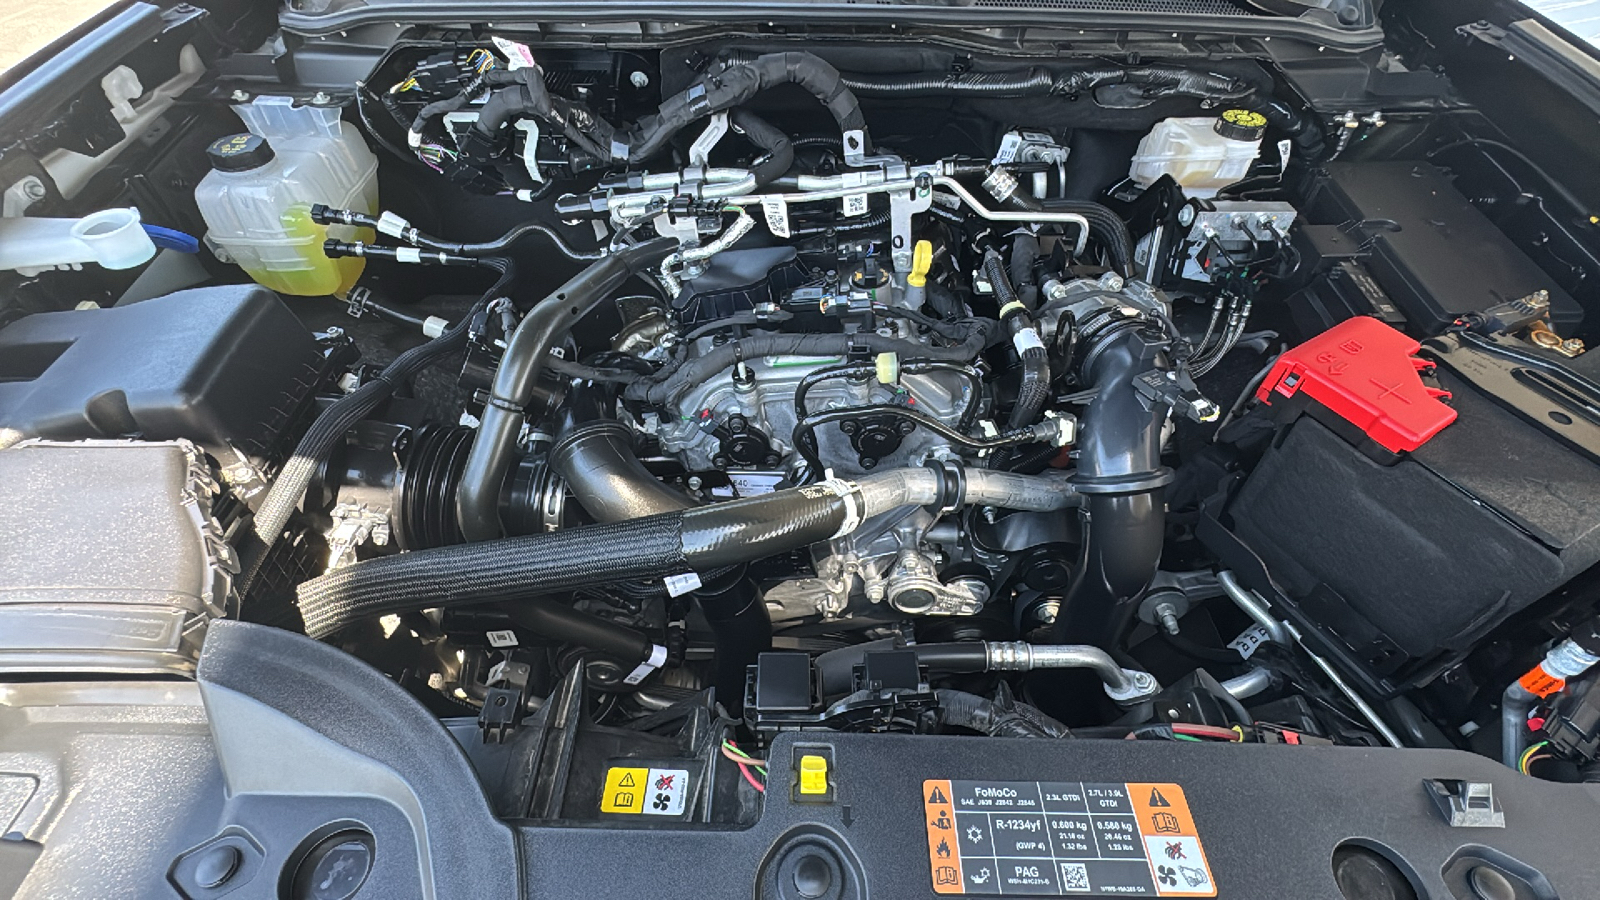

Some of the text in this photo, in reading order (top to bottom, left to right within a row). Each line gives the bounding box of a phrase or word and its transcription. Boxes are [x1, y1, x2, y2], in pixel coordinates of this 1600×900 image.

[974, 787, 1017, 797] FoMoCo
[996, 820, 1040, 832] R-1234yf
[1076, 822, 1087, 831] kg
[1122, 822, 1132, 832] kg
[1015, 866, 1039, 878] PAG
